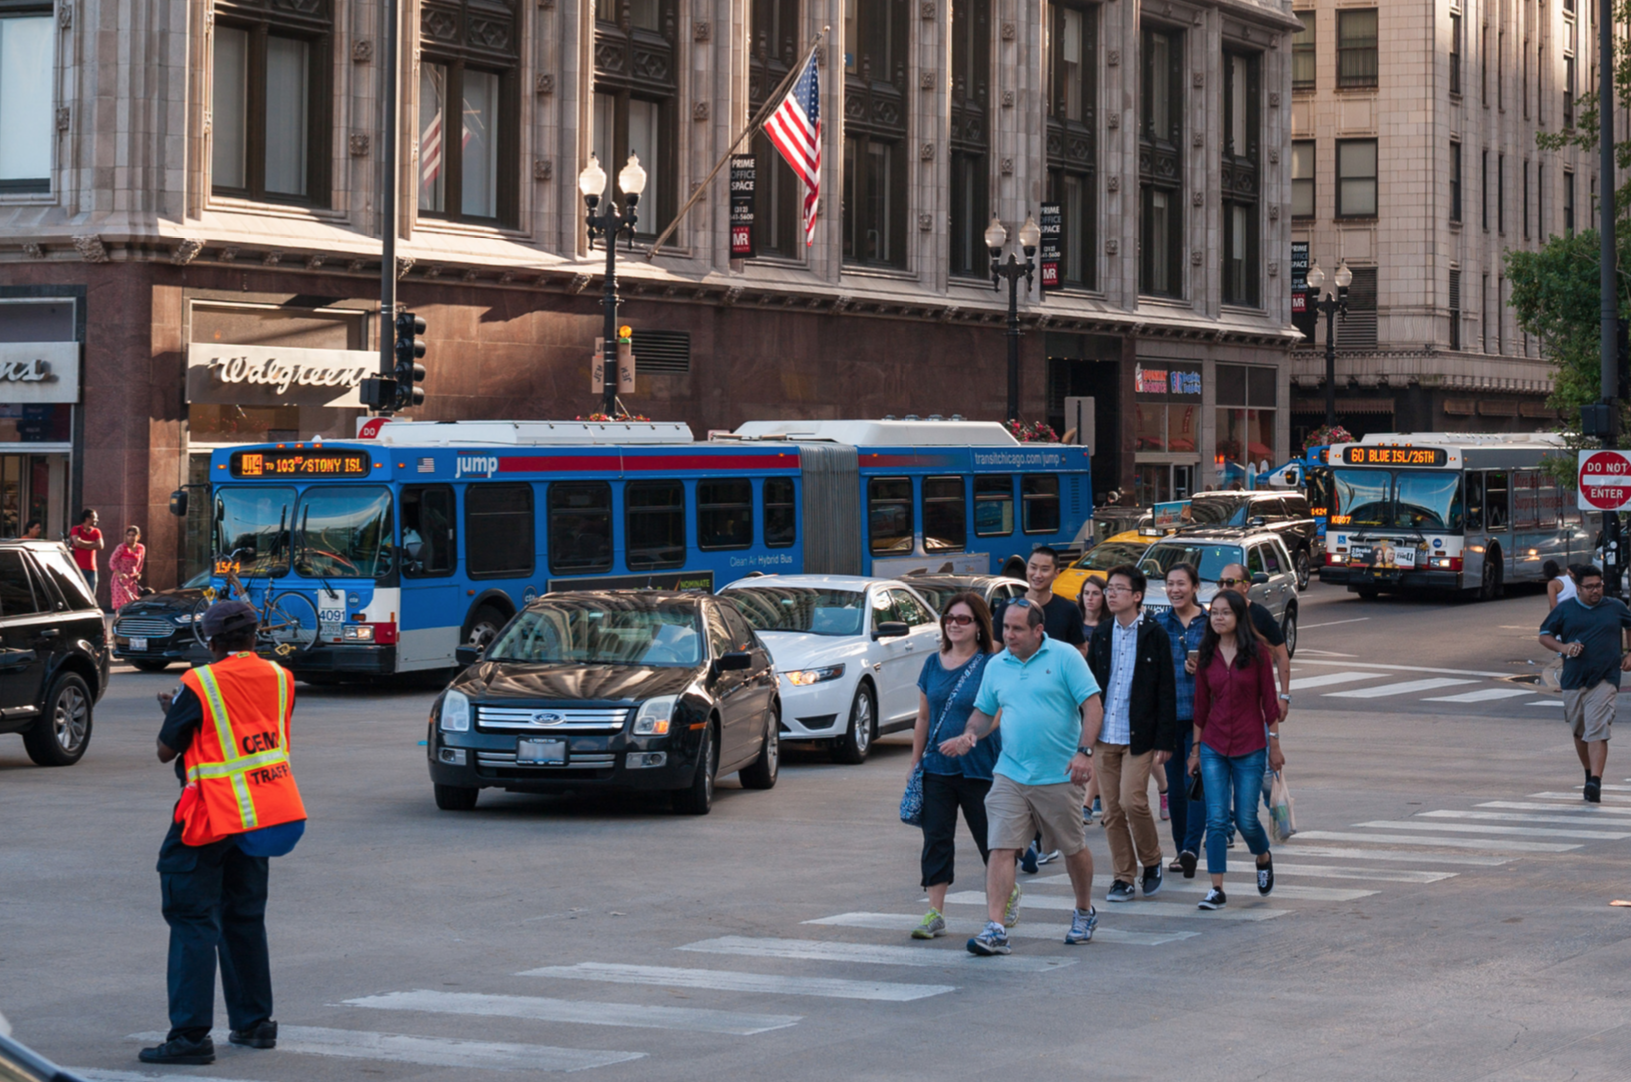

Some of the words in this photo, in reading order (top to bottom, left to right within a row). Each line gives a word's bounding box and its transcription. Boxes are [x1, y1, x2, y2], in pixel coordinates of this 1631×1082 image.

[731, 159, 755, 169] PRIME
[731, 170, 756, 180] OFFICE
[731, 181, 754, 191] SPACE
[1041, 225, 1060, 233] SPACE
[733, 233, 748, 246] MR
[1043, 268, 1056, 280] MR
[208, 356, 366, 395] Walgreen
[363, 427, 376, 436] DO
[1351, 448, 1365, 463] 60
[1369, 450, 1390, 463] BLUE
[1392, 449, 1435, 464] ISL/26TH
[345, 458, 363, 472] ISL
[455, 456, 498, 479] jump
[1587, 462, 1602, 472] DO
[1606, 462, 1628, 473] NOT
[1591, 488, 1624, 499] ENTER
[780, 553, 793, 564] Bus
[680, 579, 710, 589] NOMINATE
[319, 610, 346, 622] 4091
